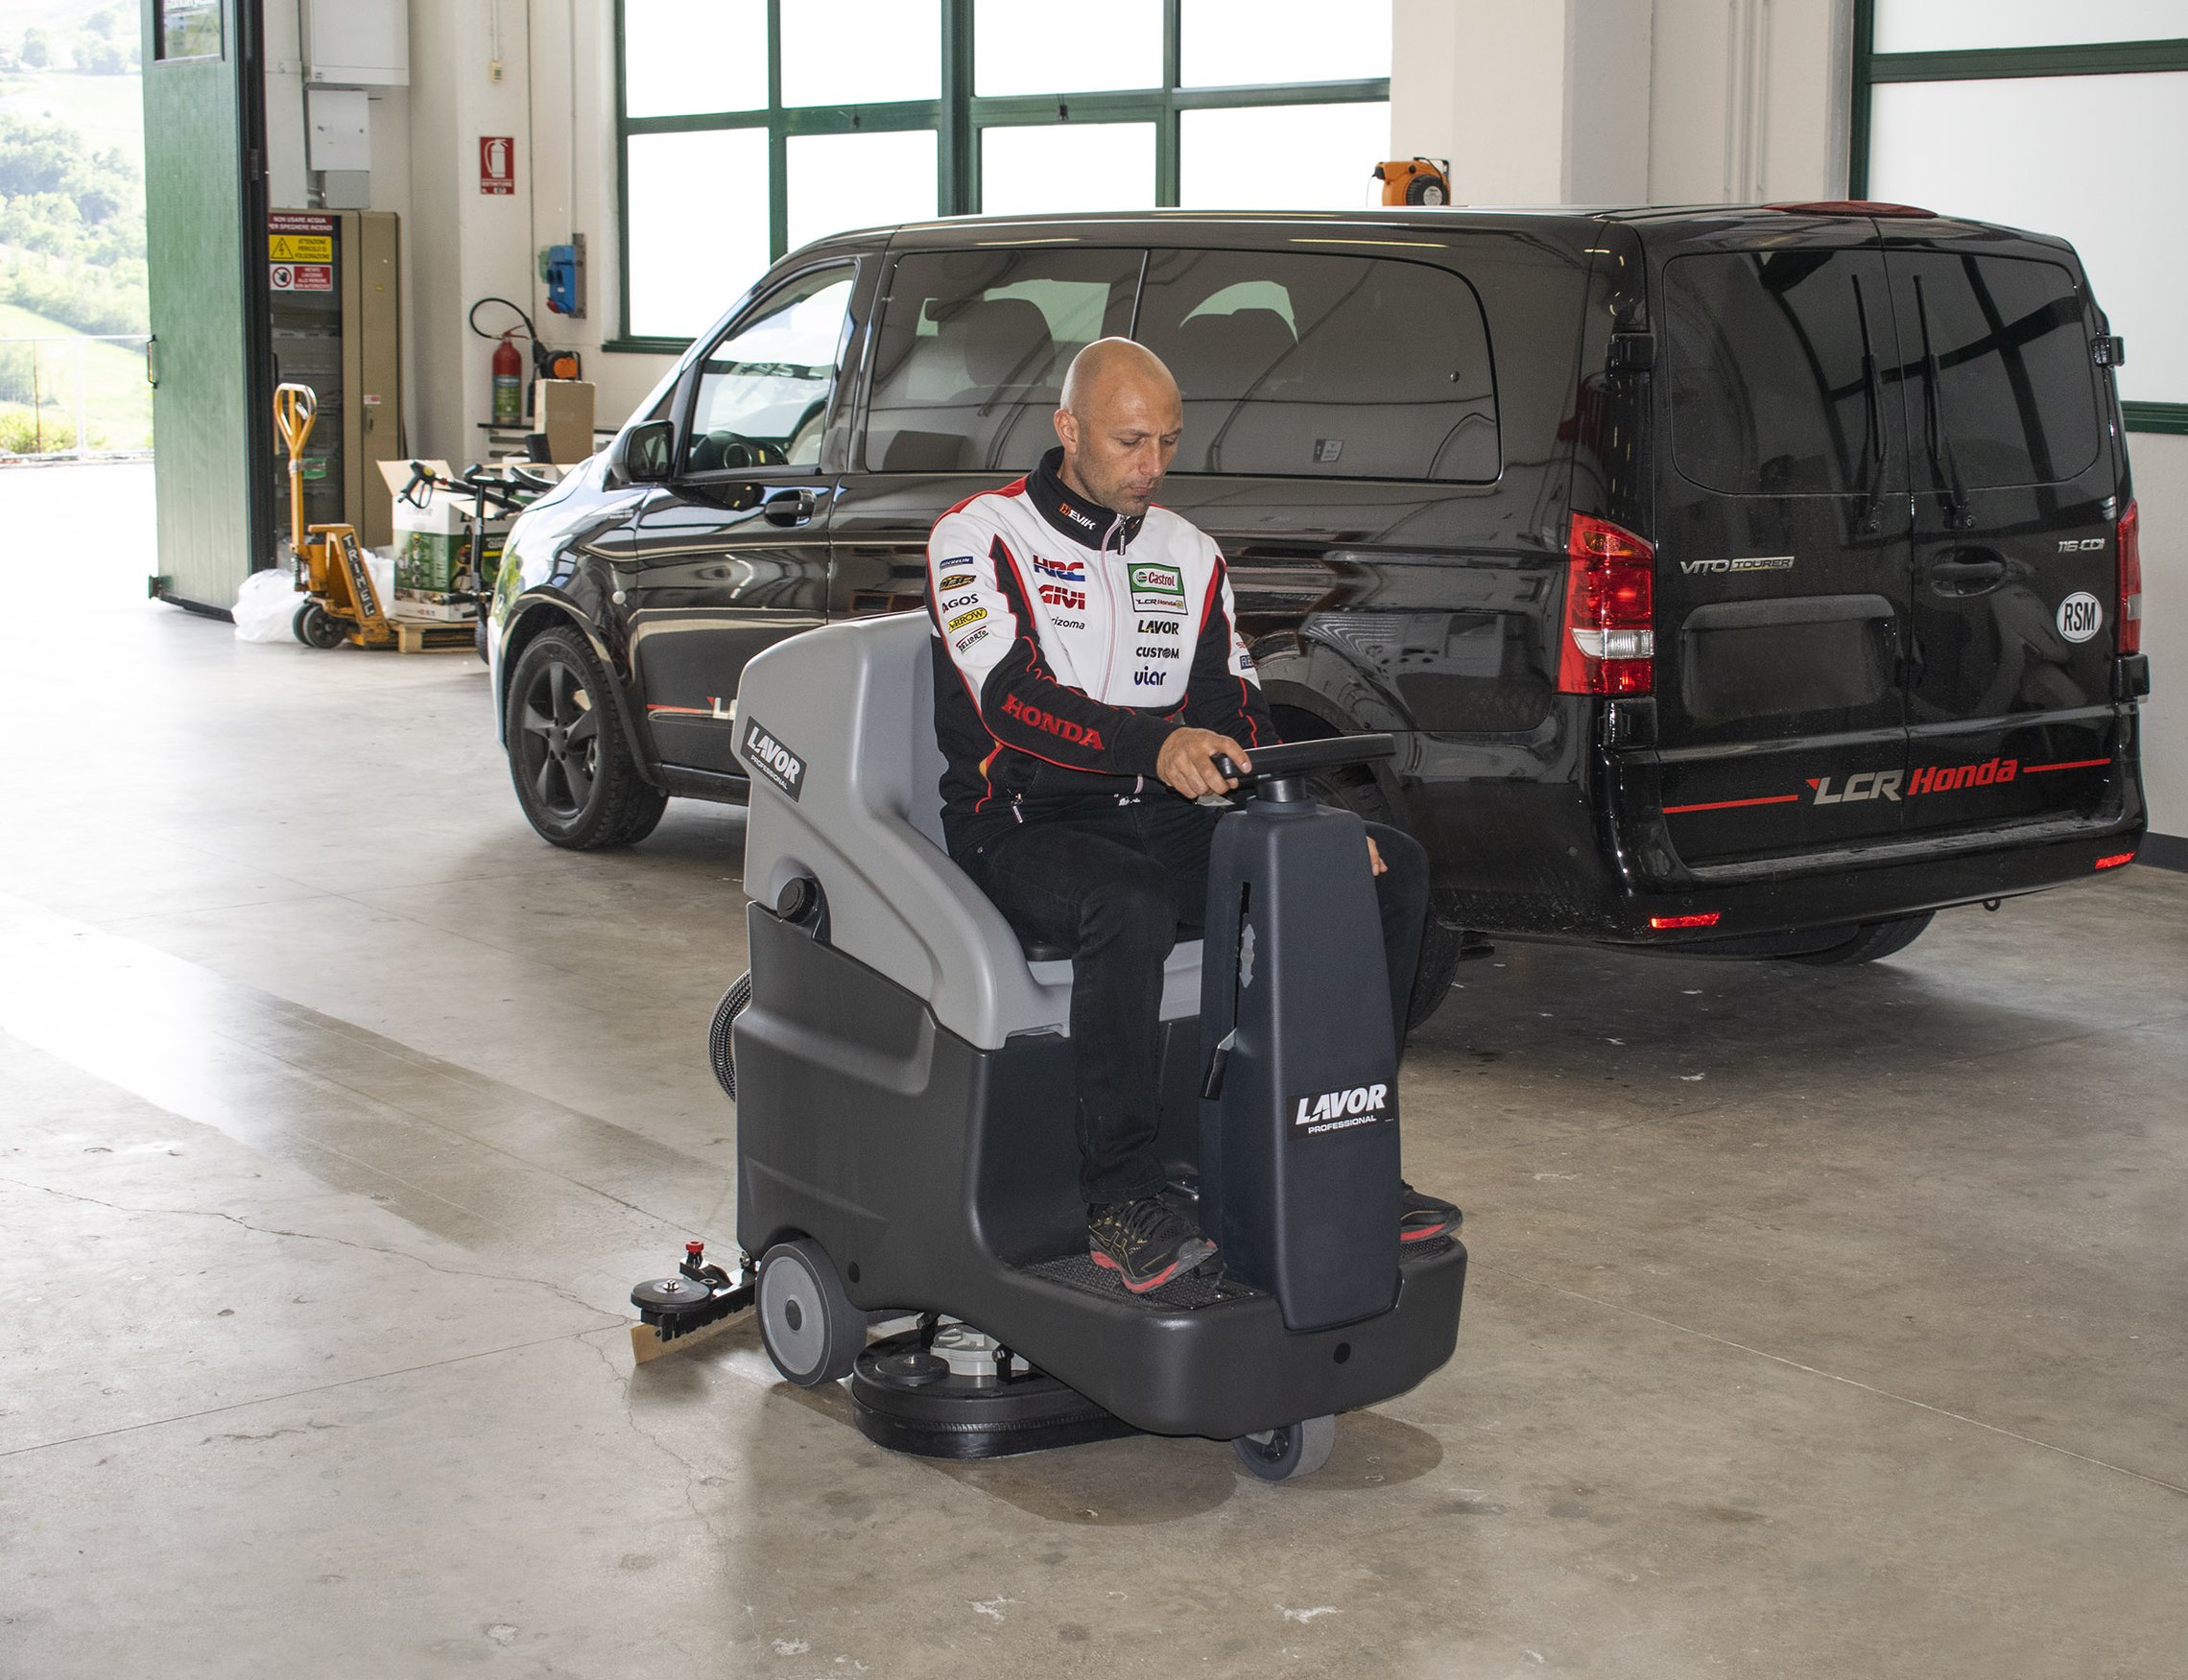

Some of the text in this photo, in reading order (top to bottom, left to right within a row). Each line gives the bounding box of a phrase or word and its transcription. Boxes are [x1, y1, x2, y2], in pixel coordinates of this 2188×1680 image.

[1033, 555, 1086, 582] HRC
[1148, 571, 1176, 587] Castrol
[1679, 558, 1792, 576] VITO TOURER
[941, 594, 979, 614] AGOS
[1037, 583, 1086, 610] GIVI
[948, 608, 985, 629] ARROW
[1137, 620, 1179, 635] LAVOR
[2063, 602, 2096, 631] RSM
[1135, 646, 1179, 659] CUSTOM
[1001, 693, 1106, 750] HONDA
[747, 725, 801, 785] LAVOR
[750, 754, 789, 790] PROFESSIONAL
[1813, 757, 2019, 806] LCR Honda
[1295, 1083, 1388, 1125] LAVOR
[1307, 1114, 1378, 1134] PROFESSIONAL
